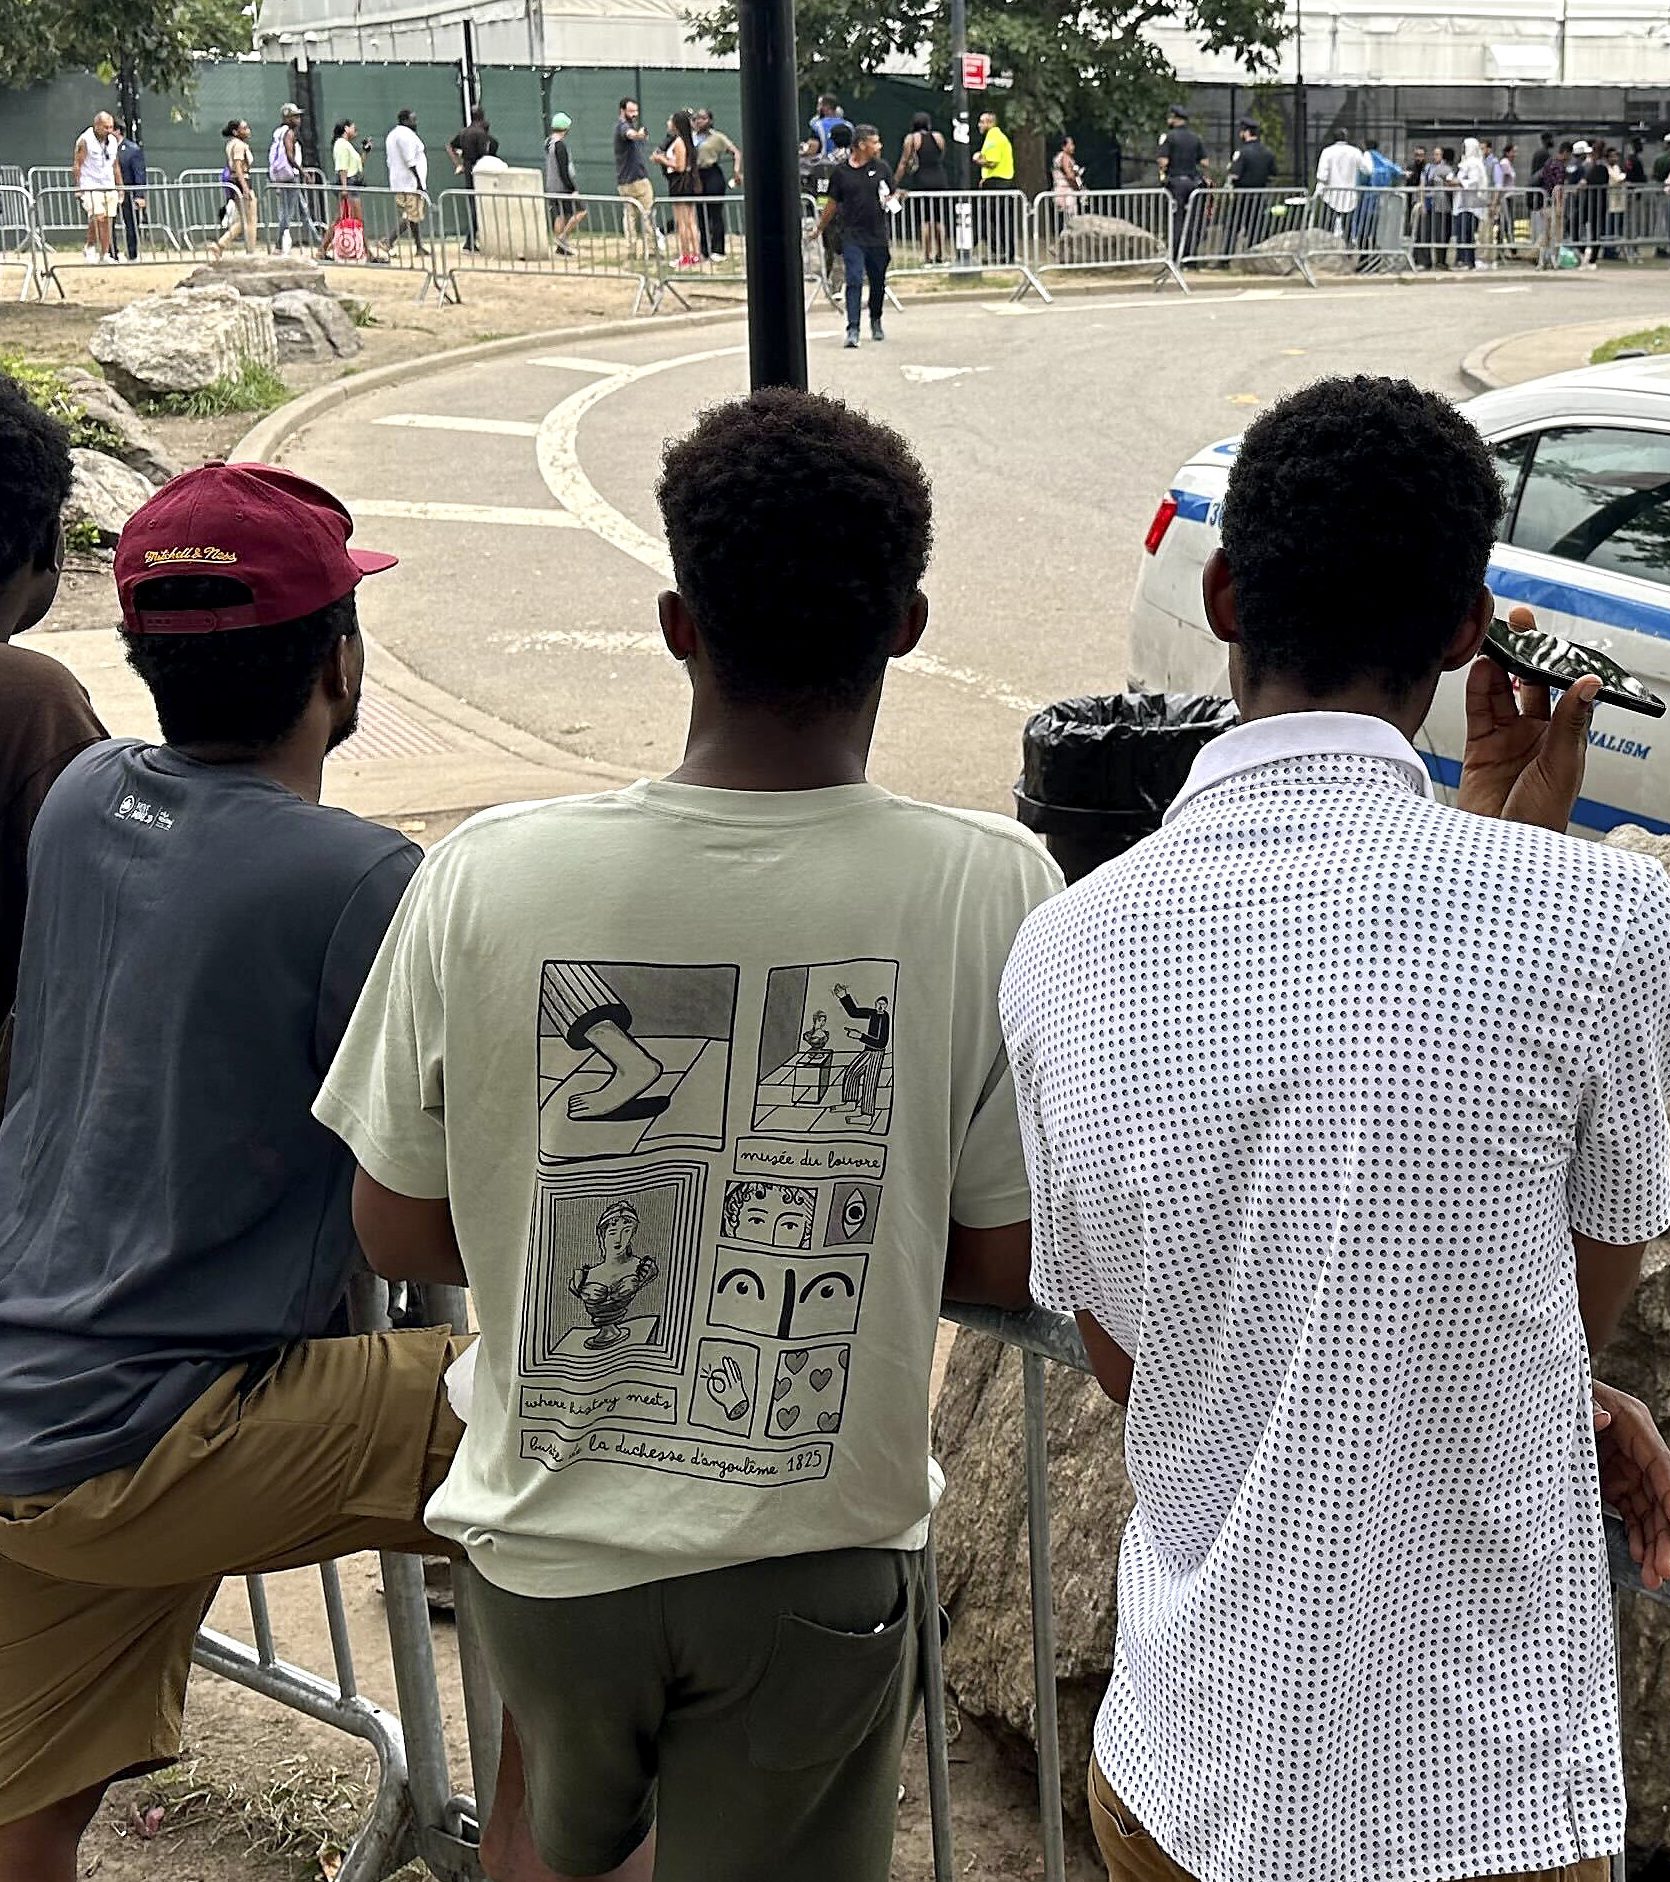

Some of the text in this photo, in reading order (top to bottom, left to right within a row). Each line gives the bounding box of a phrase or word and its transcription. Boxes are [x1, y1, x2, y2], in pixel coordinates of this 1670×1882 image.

[144, 546, 237, 563] Mitchell & Ness
[740, 1149, 880, 1168] musée du louvre
[525, 1392, 672, 1416] where history meets
[589, 1433, 610, 1451] la
[616, 1433, 685, 1463] duchesse
[690, 1446, 779, 1479] d'angoulême
[786, 1449, 822, 1472] 1825
